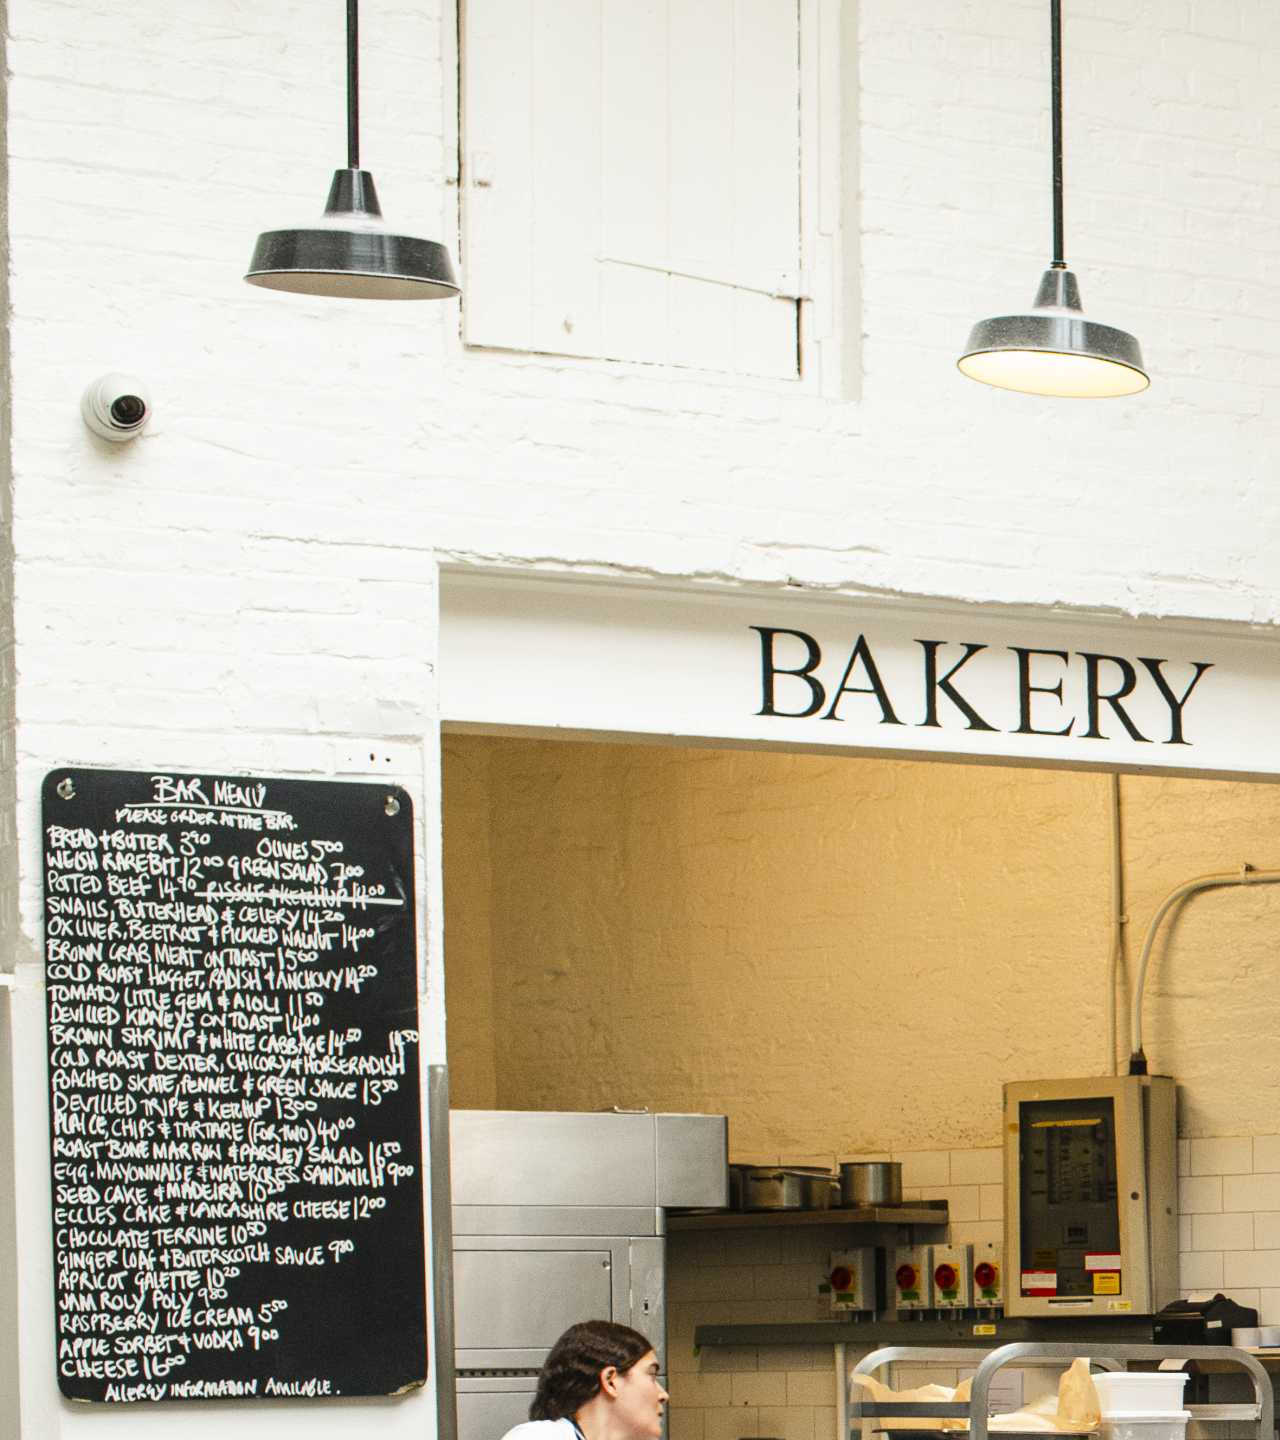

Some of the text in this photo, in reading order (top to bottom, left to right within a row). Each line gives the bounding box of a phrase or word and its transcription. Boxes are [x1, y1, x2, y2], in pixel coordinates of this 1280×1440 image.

[749, 626, 1215, 745] BAKERY
[151, 775, 266, 808] BAR MENU
[115, 807, 167, 825] PLEASE
[170, 810, 218, 825] ORDER
[46, 825, 98, 849] BREAD
[111, 829, 175, 855] BUTTER
[257, 837, 309, 862] OLIVES
[46, 851, 99, 871] WELSH
[102, 852, 180, 877] RAREBIT
[227, 855, 280, 880] GREEN
[280, 862, 328, 884] SALAD
[48, 871, 102, 894] POTTED
[107, 873, 152, 897] BEEF
[47, 897, 115, 922] SNAILS,
[115, 899, 219, 925] BUTTERHEAD
[239, 906, 300, 930] CELERY
[48, 915, 74, 936] OX
[75, 919, 128, 942] LIVER,
[127, 919, 208, 943] BEETROOT
[221, 924, 279, 946] PICKLED
[282, 927, 339, 951] WALNUT
[46, 938, 103, 962] BROWN
[109, 942, 151, 964] CRAB
[155, 943, 202, 968] MEAT
[204, 950, 224, 969] ON
[223, 949, 276, 969] TOAST
[48, 964, 91, 981] COLD
[97, 963, 143, 985] ROAST
[149, 963, 206, 991] HOGGET,
[209, 967, 262, 991] RADISH
[276, 967, 343, 992] ANCHOVY
[48, 984, 120, 1004] TOMATO,
[124, 987, 171, 1011] LITTLE
[174, 991, 213, 1012] GEM
[233, 992, 280, 1015] AIOLI
[50, 1002, 120, 1026] DEVILLED
[126, 1004, 195, 1030] KIDNEYS
[200, 1012, 226, 1029] ON
[227, 1012, 282, 1033] TOAST
[50, 1025, 112, 1048] BROWN
[121, 1027, 196, 1050] SHRIMP
[209, 1028, 256, 1051] WHITE
[259, 1033, 325, 1059] CABBAGE
[50, 1047, 90, 1068] COLD
[96, 1048, 149, 1070] ROAST
[154, 1052, 225, 1073] DEXTER,
[226, 1053, 291, 1077] CHICORY
[304, 1054, 405, 1075] HORSERADISH
[51, 1069, 122, 1091] POACHED
[127, 1074, 181, 1104] SKATE,
[180, 1074, 239, 1095] FENNEL
[257, 1075, 307, 1098] GREEN
[309, 1078, 357, 1099] SAUCE
[53, 1091, 137, 1115] DEVILLED
[140, 1097, 189, 1118] TRIPE
[111, 1118, 155, 1139] CHIPS
[174, 1120, 244, 1143] TARTARE
[248, 1119, 282, 1147] (FOR
[54, 1138, 105, 1160] ROAST
[105, 1138, 150, 1160] BONE
[152, 1141, 222, 1160] MARROW
[239, 1143, 303, 1168] PARSLEY
[308, 1146, 364, 1165] SALAD
[96, 1160, 194, 1184] MAYONNAISE
[209, 1163, 301, 1184] WATERCRESS
[302, 1164, 385, 1188] SANDWICH
[56, 1184, 100, 1204] SEED
[104, 1185, 149, 1206] CAKE
[166, 1180, 243, 1201] MADEIRA
[55, 1205, 117, 1226] ECCLES
[123, 1205, 171, 1224] CAKE
[190, 1202, 289, 1222] LANCASHIRE
[293, 1199, 350, 1219] CHEESE
[56, 1228, 149, 1249] CHOCOLATE
[152, 1226, 228, 1247] TERRINE
[57, 1251, 119, 1274] GINGER
[122, 1248, 156, 1271] LOAF
[171, 1242, 271, 1269] BUTTERSCOTCH
[275, 1246, 325, 1266] SAUCE
[58, 1269, 128, 1291] APRICOT
[134, 1270, 201, 1294] GALETTE
[59, 1291, 97, 1312] JAM
[101, 1291, 145, 1315] ROLY
[152, 1290, 194, 1310] POLY
[60, 1312, 160, 1336] RASPBERRY
[167, 1308, 193, 1328] ICE
[193, 1307, 255, 1328] CREAM
[60, 1338, 110, 1359] APPLE
[114, 1333, 178, 1354] SORBET
[192, 1329, 244, 1352] VODKA
[61, 1358, 140, 1379] CHEESE
[104, 1382, 167, 1402] ALLERGY
[170, 1379, 258, 1398] INFORMATION
